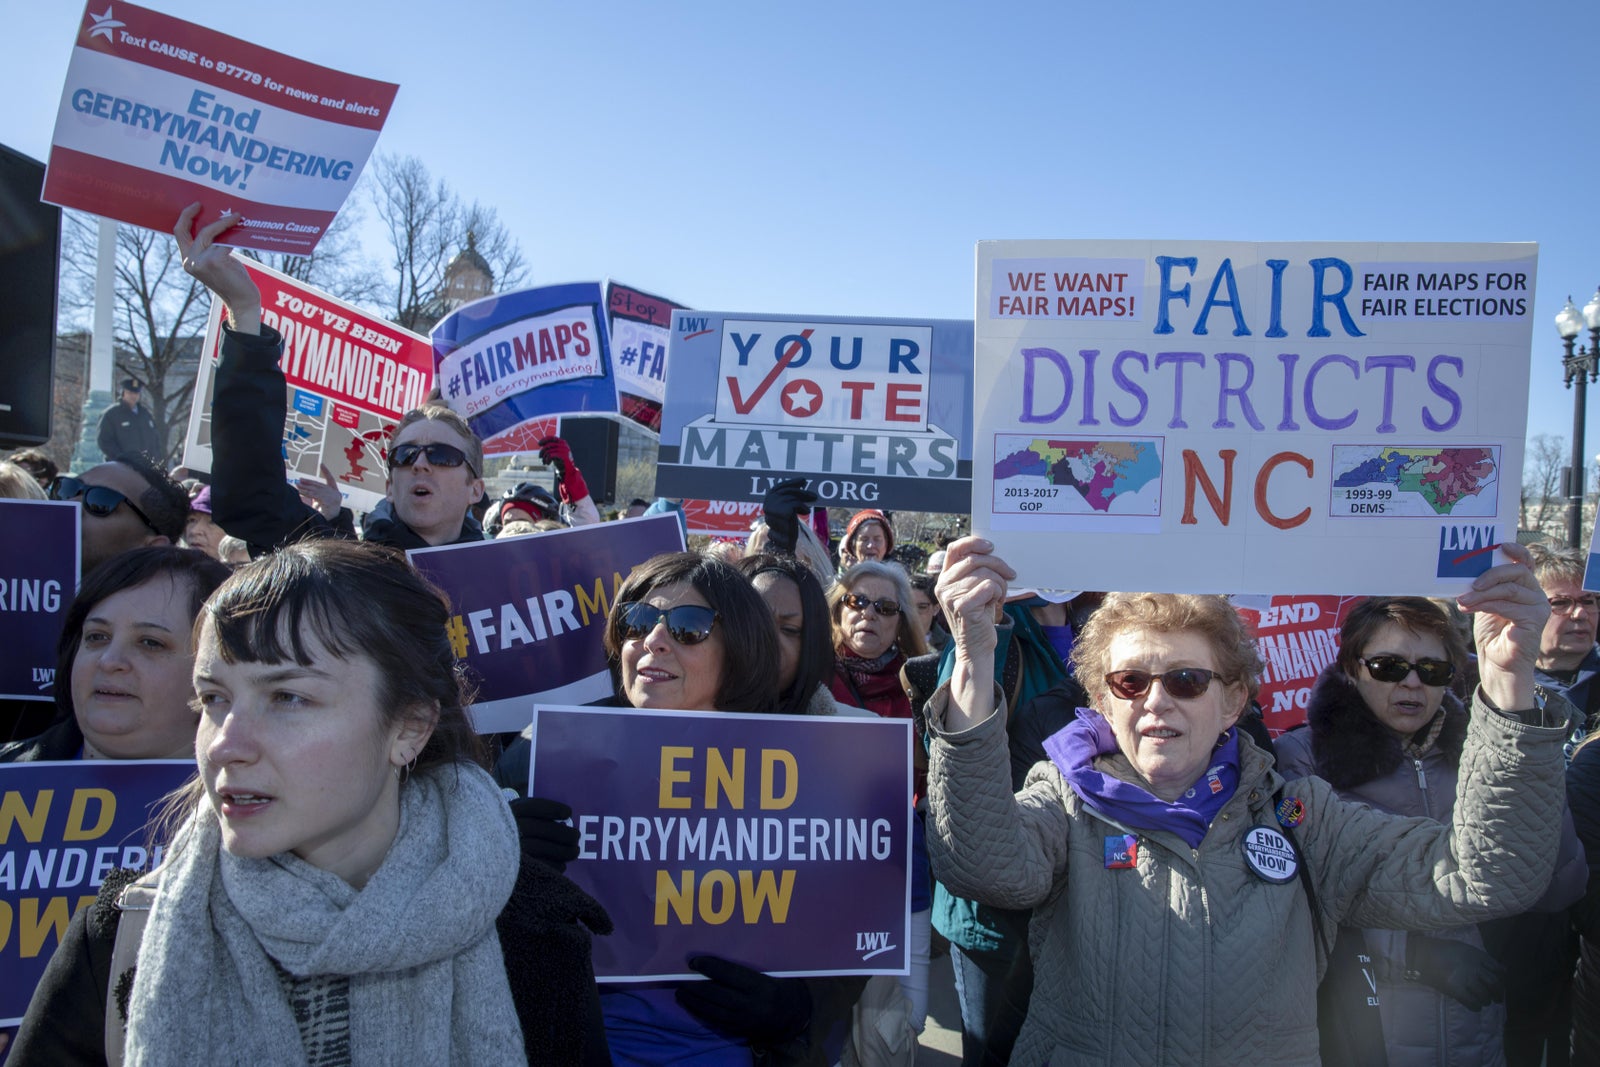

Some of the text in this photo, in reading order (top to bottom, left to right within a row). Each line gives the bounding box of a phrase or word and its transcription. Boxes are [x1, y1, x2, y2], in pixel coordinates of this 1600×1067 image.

[120, 31, 380, 117] Text CAUSE to 97779 for news and alerts
[187, 88, 262, 134] End
[71, 88, 354, 182] GERRYMANDERING
[159, 139, 255, 190] Now!
[285, 222, 321, 234] Cause
[1008, 272, 1128, 294] WE WANT
[1153, 255, 1367, 339] FAIR
[1364, 272, 1527, 292] FAIR MAPS FOR
[275, 290, 403, 354] YOU'VE BEEN
[678, 317, 709, 333] LWV
[998, 296, 1136, 318] FAIR MAPS!
[1361, 297, 1527, 317] FAIR ELECTIONS
[448, 321, 591, 399] #FAIRMAPS
[620, 340, 666, 383] #FA
[729, 332, 922, 375] YOUR
[466, 360, 599, 414] Stop Gerrymandering!
[726, 366, 922, 423] VOTE
[1019, 347, 1464, 434] DISTRICTS
[683, 427, 955, 478] MATTERS
[1004, 488, 1059, 498] 2013-2017
[1019, 502, 1043, 511] GOP
[1180, 449, 1315, 530] NC
[1345, 489, 1392, 500] 1993-99
[1351, 503, 1385, 514] DEMS
[1442, 525, 1495, 551] LWV
[446, 565, 642, 658] #FAIRM
[1258, 602, 1320, 628] END
[658, 745, 799, 811] END
[0, 788, 117, 845] ND
[1288, 808, 1302, 824] NC
[556, 815, 892, 861] ERRYMANDERING
[1113, 852, 1127, 861] NC
[1255, 831, 1284, 849] END
[1257, 853, 1287, 872] NOW
[654, 869, 797, 926] NOW
[856, 932, 891, 951] LWV
